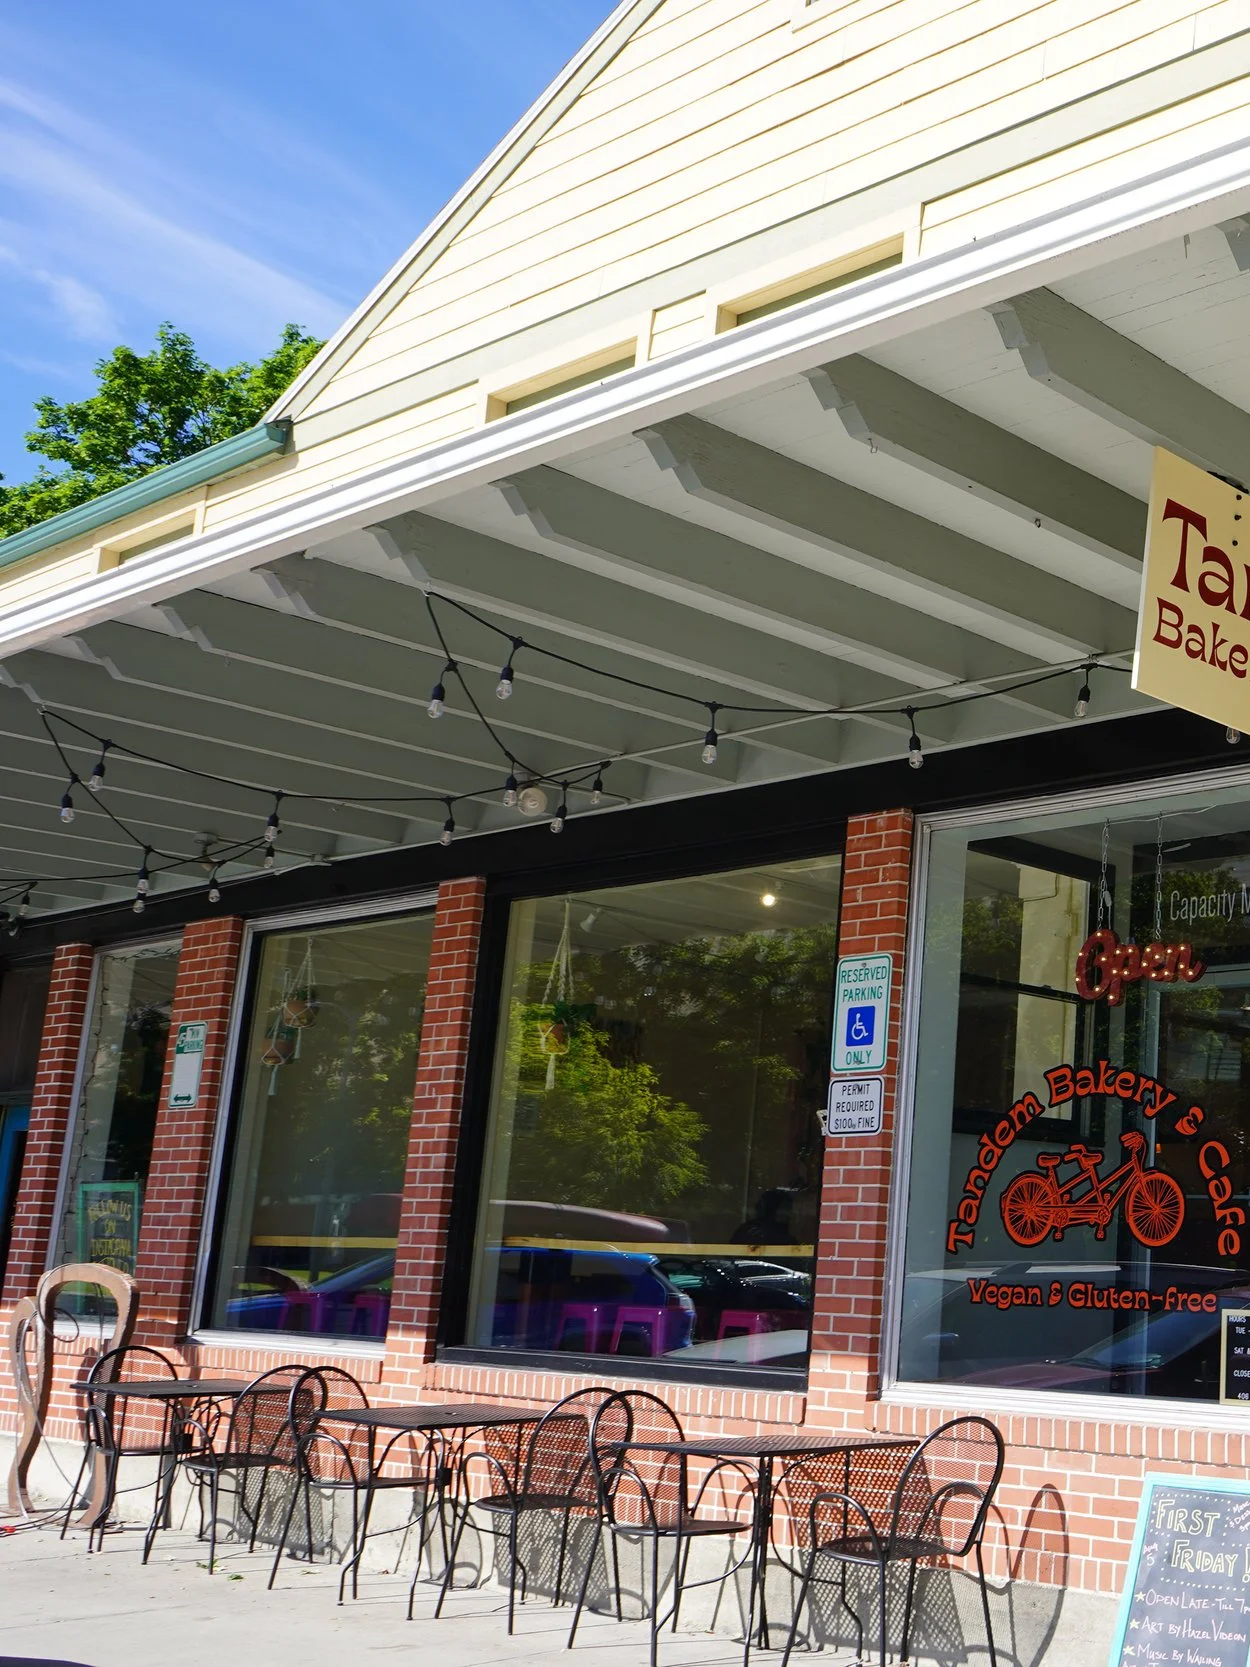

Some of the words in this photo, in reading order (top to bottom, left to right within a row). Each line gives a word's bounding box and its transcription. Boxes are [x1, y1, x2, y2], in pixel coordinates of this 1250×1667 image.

[1170, 890, 1236, 925] Capacity
[840, 965, 887, 984] RESERVED
[1075, 929, 1207, 1006] Open
[842, 985, 883, 1002] PARKING
[845, 1050, 872, 1066] ONLY
[841, 1083, 870, 1096] PERMIT
[835, 1100, 874, 1113] REQUIRED
[857, 1116, 875, 1129] FINE
[946, 1093, 1044, 1254] Tandem
[1045, 1060, 1178, 1119] Bakery
[1174, 1105, 1205, 1136] &
[1198, 1140, 1246, 1256] Cafe
[967, 1279, 1042, 1310] Vegan
[1049, 1281, 1063, 1306] &
[1067, 1282, 1217, 1312] Gluten-free
[1156, 1499, 1221, 1537] FIRST
[1146, 1554, 1155, 1567] 5
[1181, 1592, 1210, 1609] LATE
[1140, 1616, 1164, 1634] ART
[1182, 1618, 1211, 1640] HAZEL
